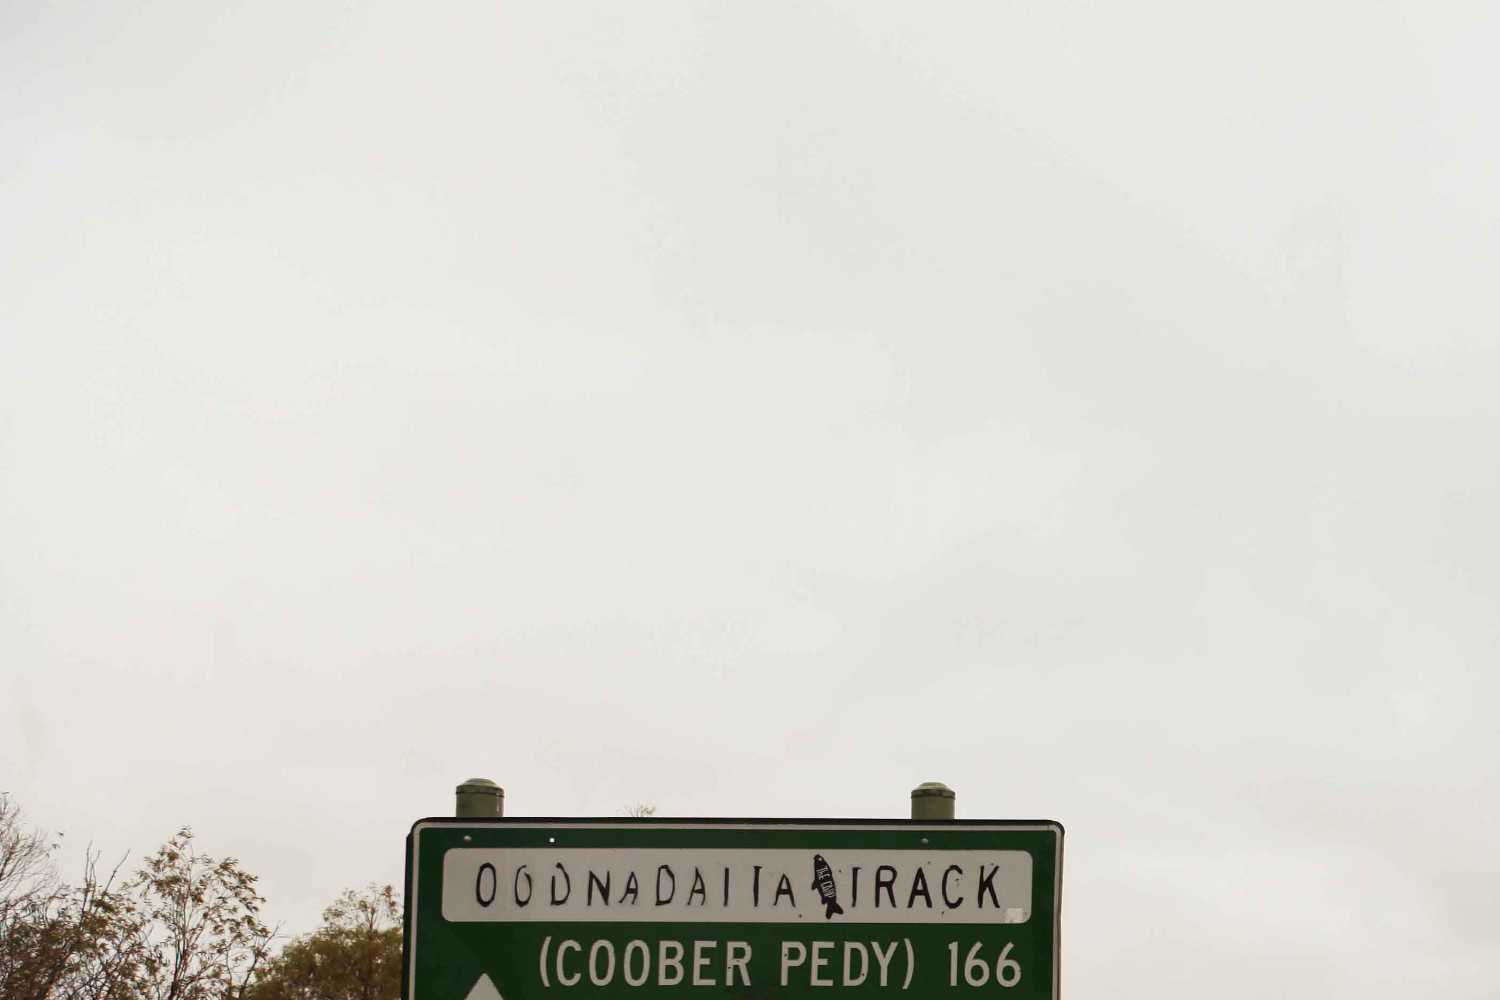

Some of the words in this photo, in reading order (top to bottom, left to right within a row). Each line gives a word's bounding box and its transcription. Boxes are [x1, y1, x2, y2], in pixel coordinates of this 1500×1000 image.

[852, 864, 1001, 910] TRACK
[540, 937, 751, 987] (COOBER
[781, 939, 914, 989] PEDY)
[949, 942, 1021, 987] 166
